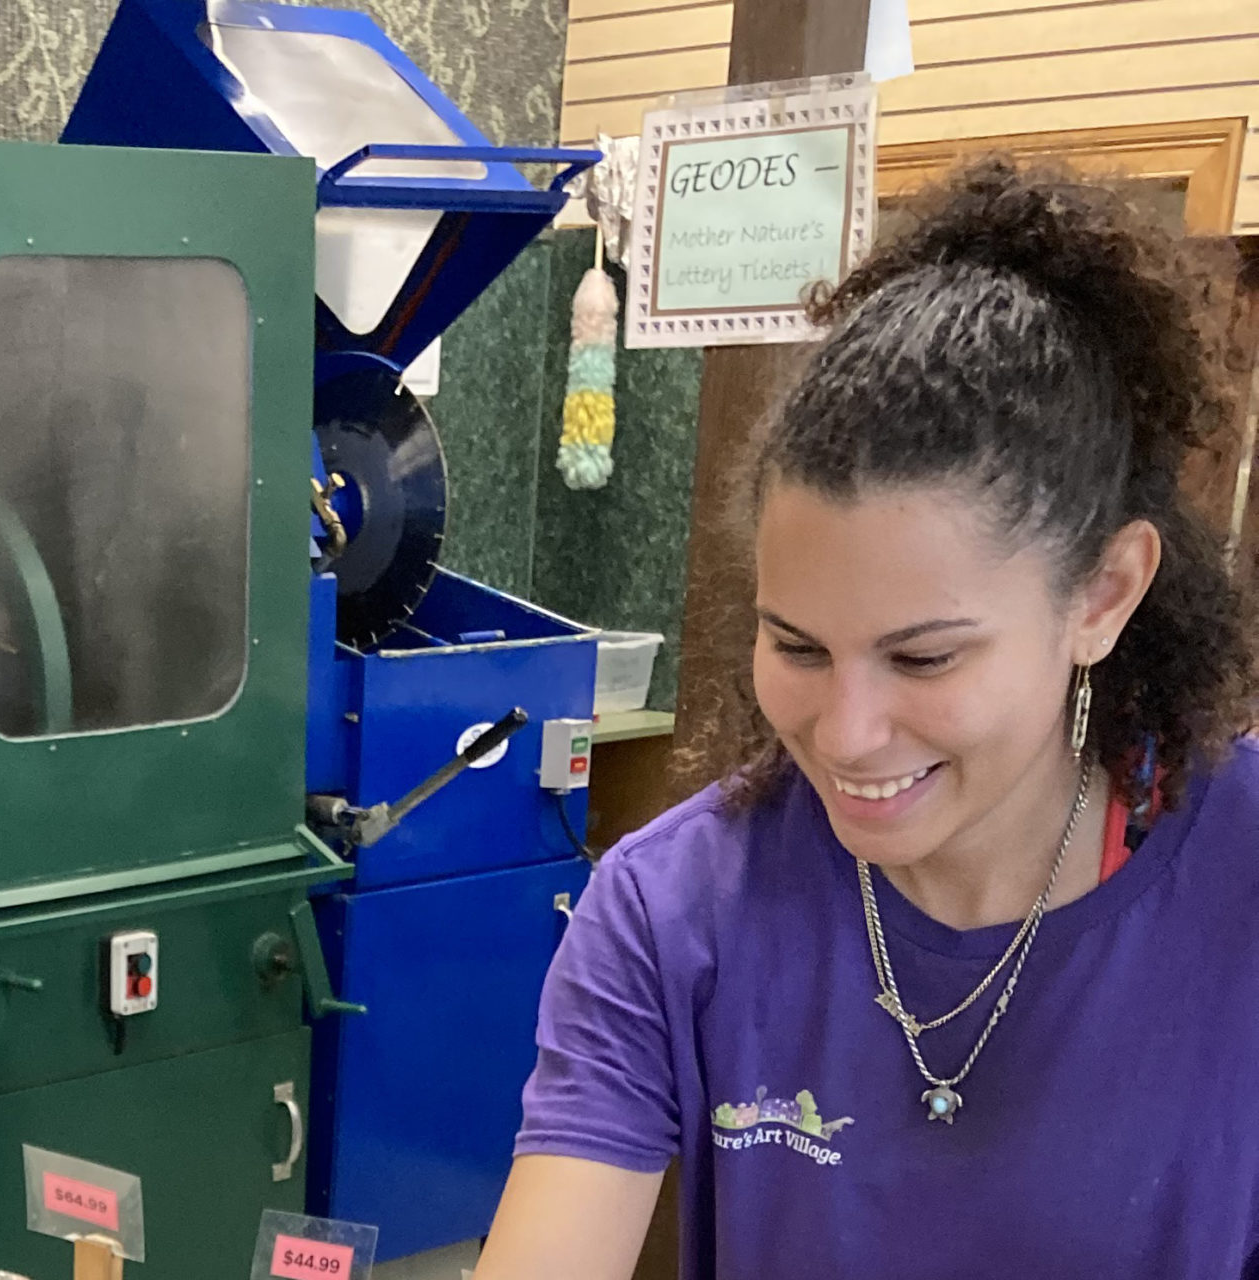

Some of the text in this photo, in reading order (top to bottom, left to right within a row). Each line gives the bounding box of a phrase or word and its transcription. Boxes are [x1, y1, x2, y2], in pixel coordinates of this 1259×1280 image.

[670, 153, 800, 198] GEODES
[669, 219, 825, 249] Mother Nature's
[665, 263, 733, 295] Lottery
[711, 1127, 841, 1165] ure's Art Village
[54, 1187, 108, 1215] $64.99
[282, 1248, 341, 1275] $44.99
